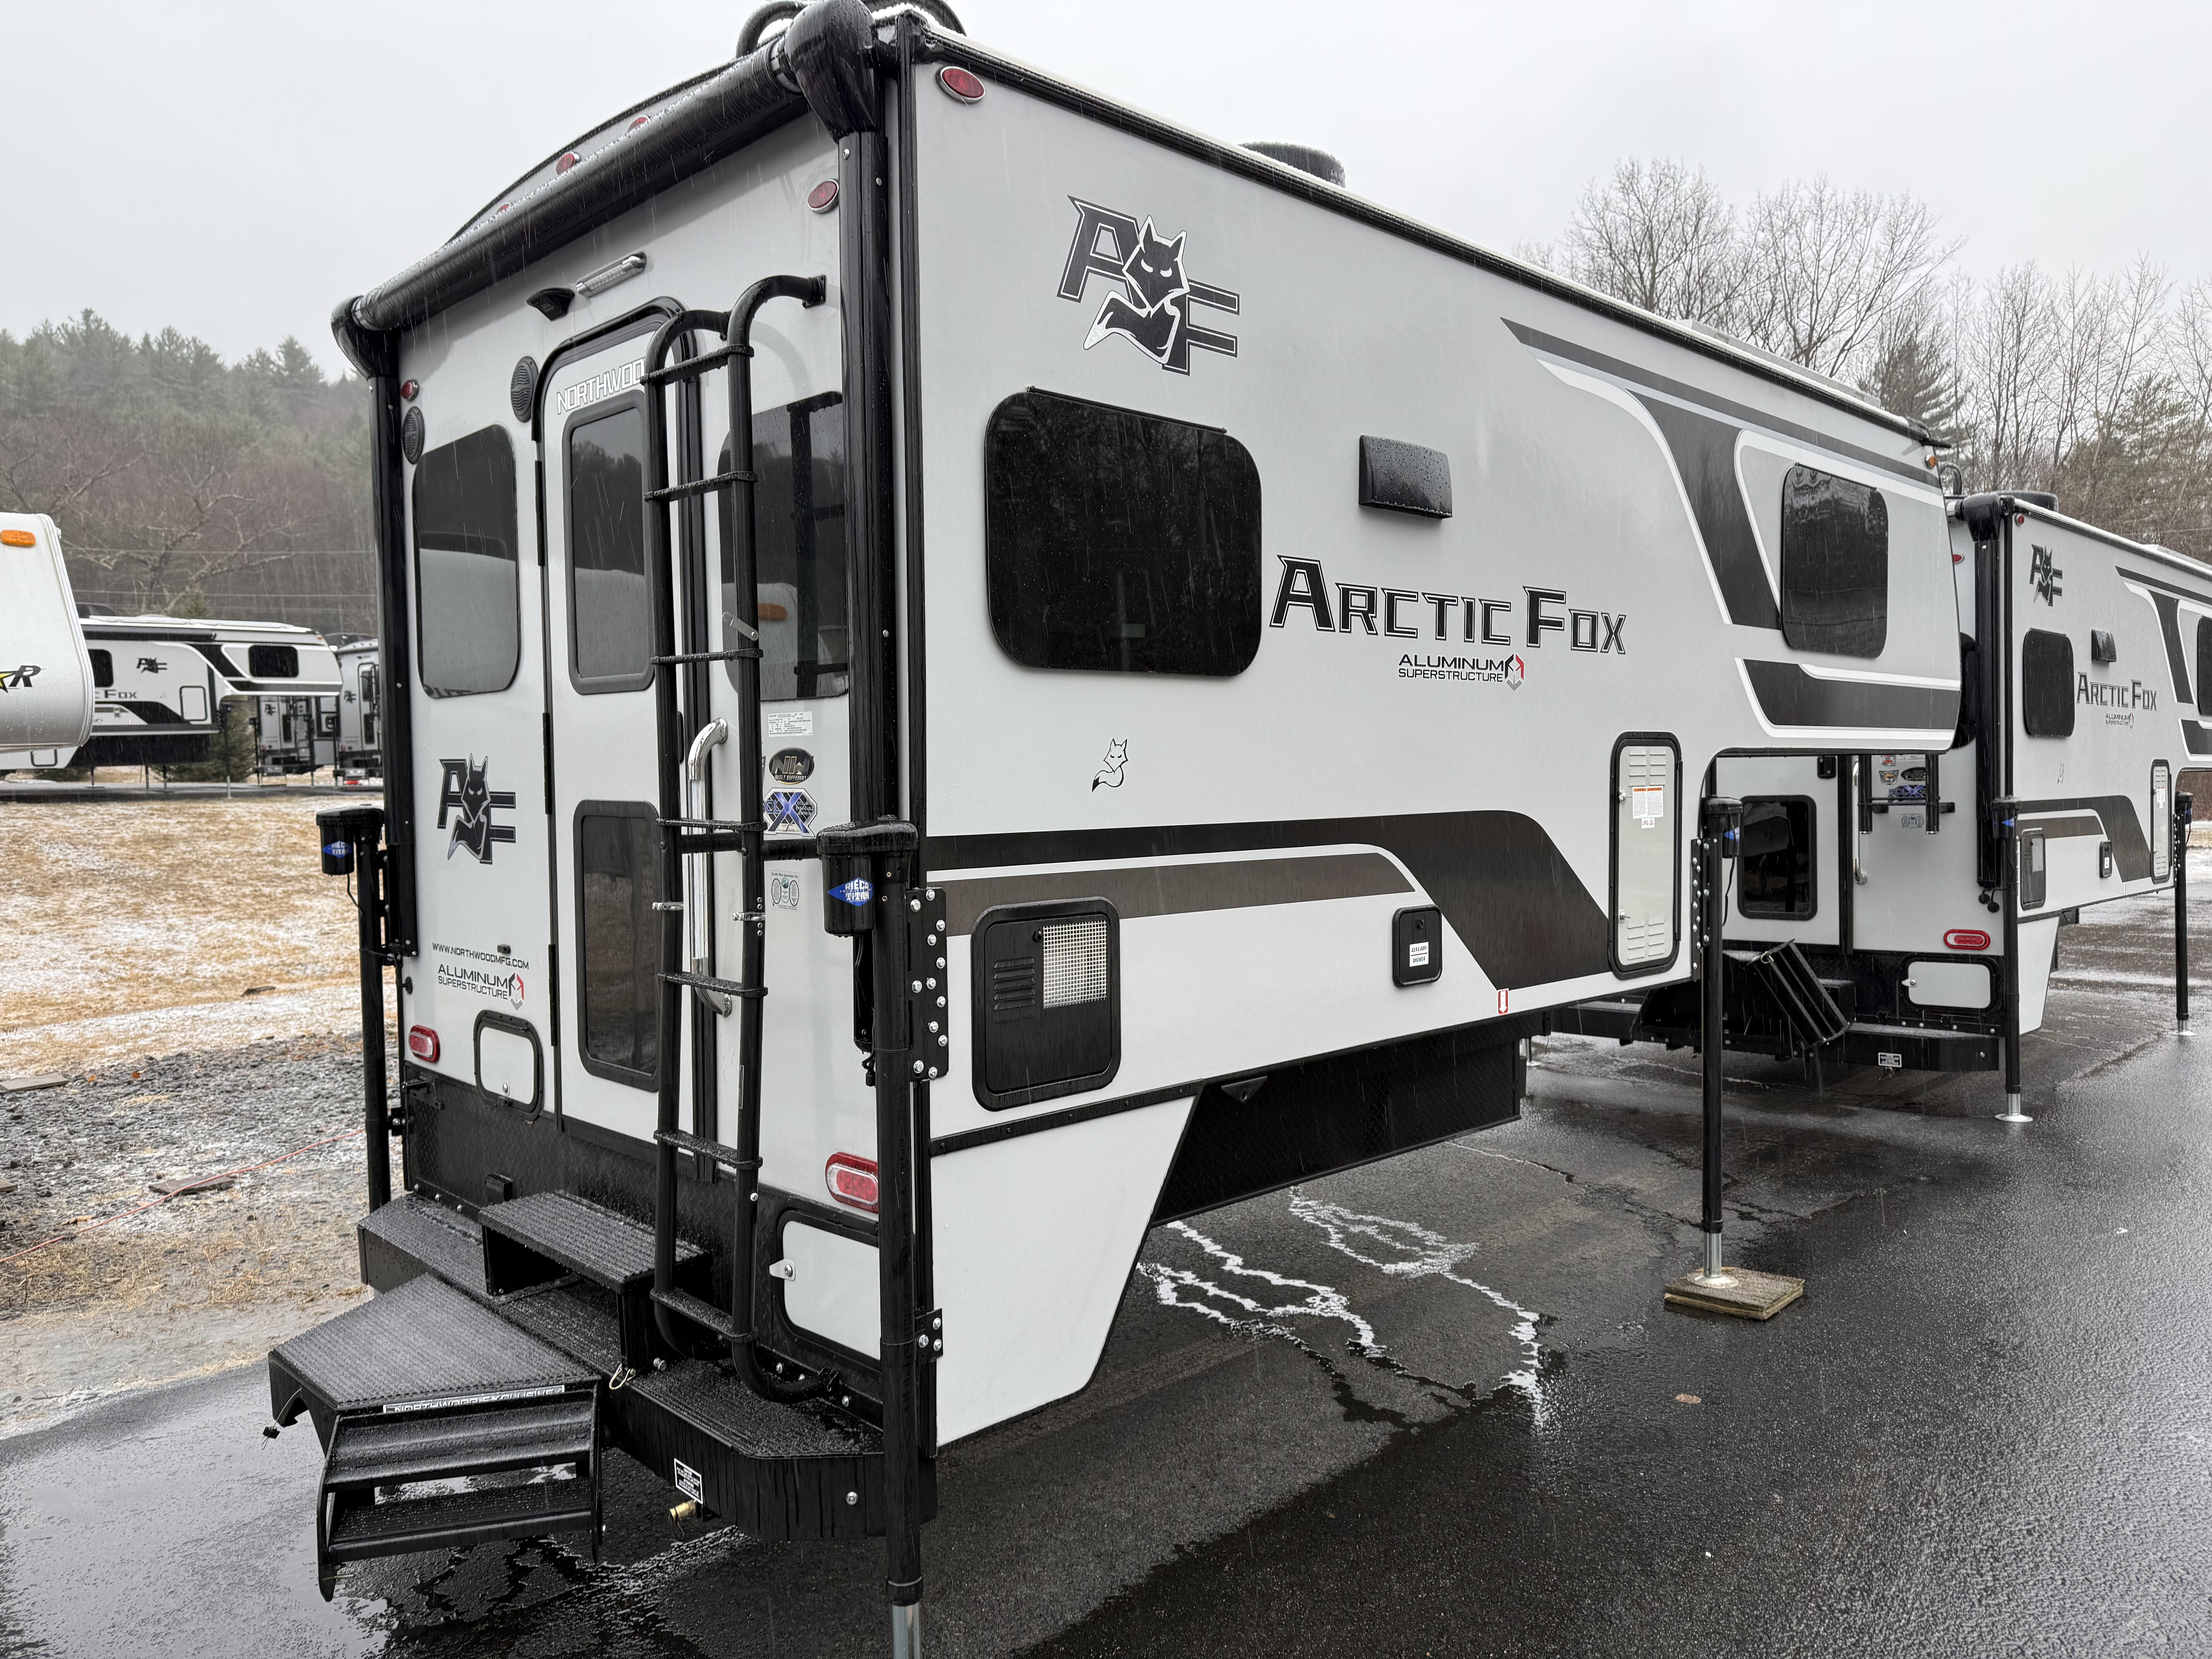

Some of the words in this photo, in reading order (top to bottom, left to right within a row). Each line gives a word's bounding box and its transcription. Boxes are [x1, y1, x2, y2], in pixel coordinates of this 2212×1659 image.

[557, 357, 646, 415] NORTHWOO
[1269, 555, 1511, 646] ARCTIC
[1523, 586, 1626, 654] FOX
[1398, 654, 1504, 671] ALUMINUM
[1398, 668, 1503, 682] SUPERSTRUCTURE
[2076, 671, 2128, 708] ARCTIC
[2131, 679, 2157, 711] FOX
[845, 879, 869, 890] RIECO
[845, 891, 869, 900] TITAN
[432, 943, 529, 970] WWW.NORTHWOODMFG.COM
[438, 964, 508, 989] ALUMINUM
[438, 976, 508, 1000] SUPERSTRUCTURE
